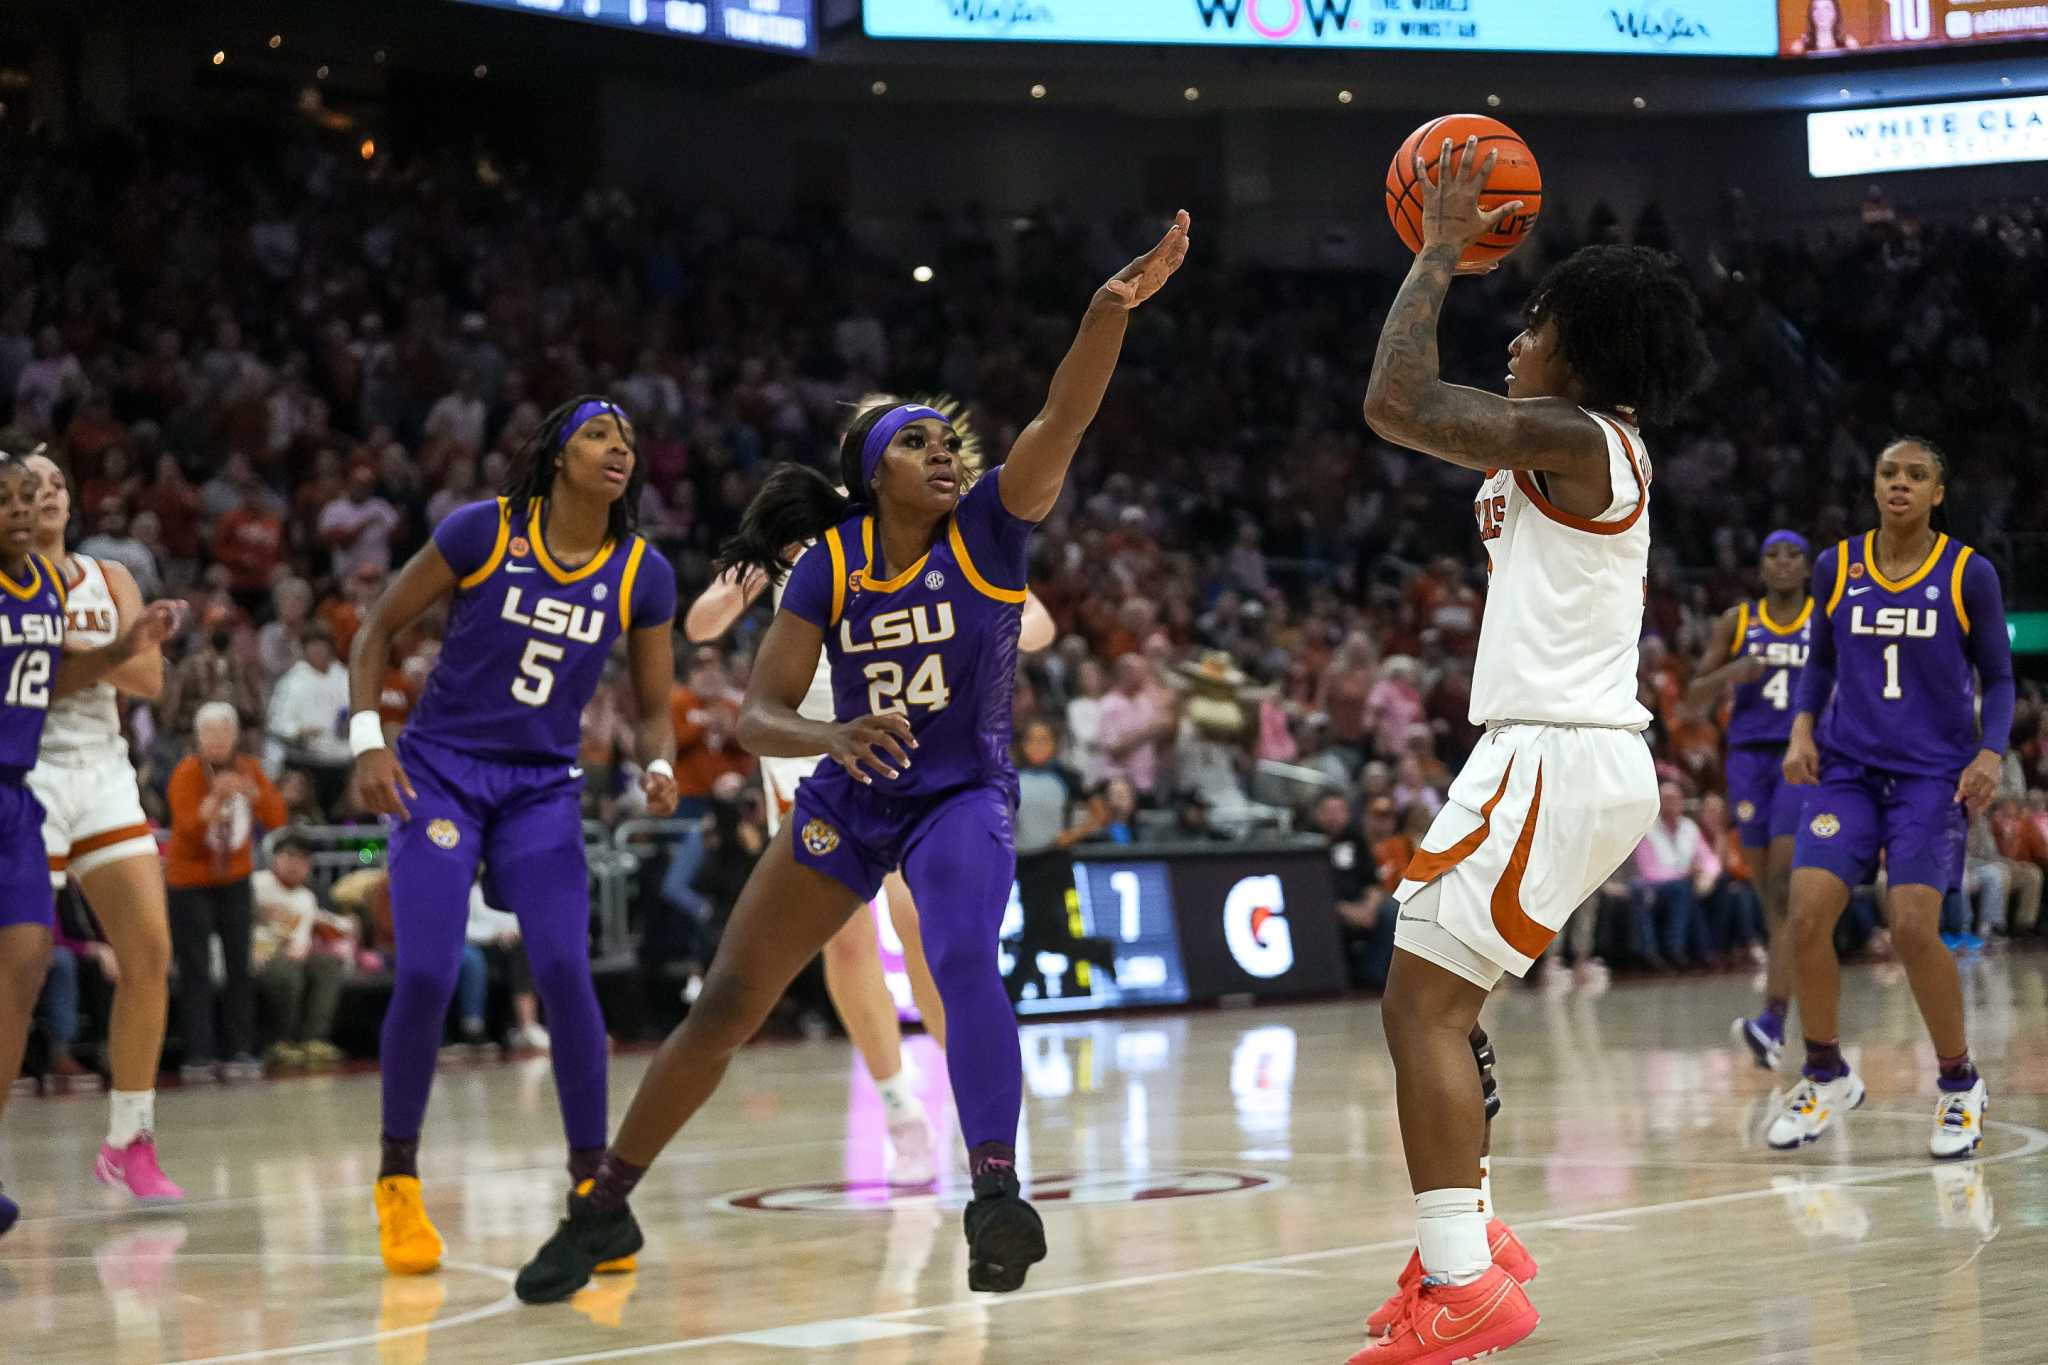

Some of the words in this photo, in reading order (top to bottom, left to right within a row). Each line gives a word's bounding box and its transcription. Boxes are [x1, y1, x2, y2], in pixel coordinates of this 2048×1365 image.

[1846, 113, 1959, 138] WHITE
[0, 614, 64, 646] LSU
[501, 586, 605, 643] LSU
[840, 601, 956, 653] LSU
[1851, 606, 1938, 637] LSU
[5, 649, 51, 708] 12
[511, 639, 565, 706] 5
[863, 654, 950, 718] 24
[1762, 669, 1789, 710] 4
[1883, 644, 1902, 699] 1
[1223, 874, 1294, 978] G
